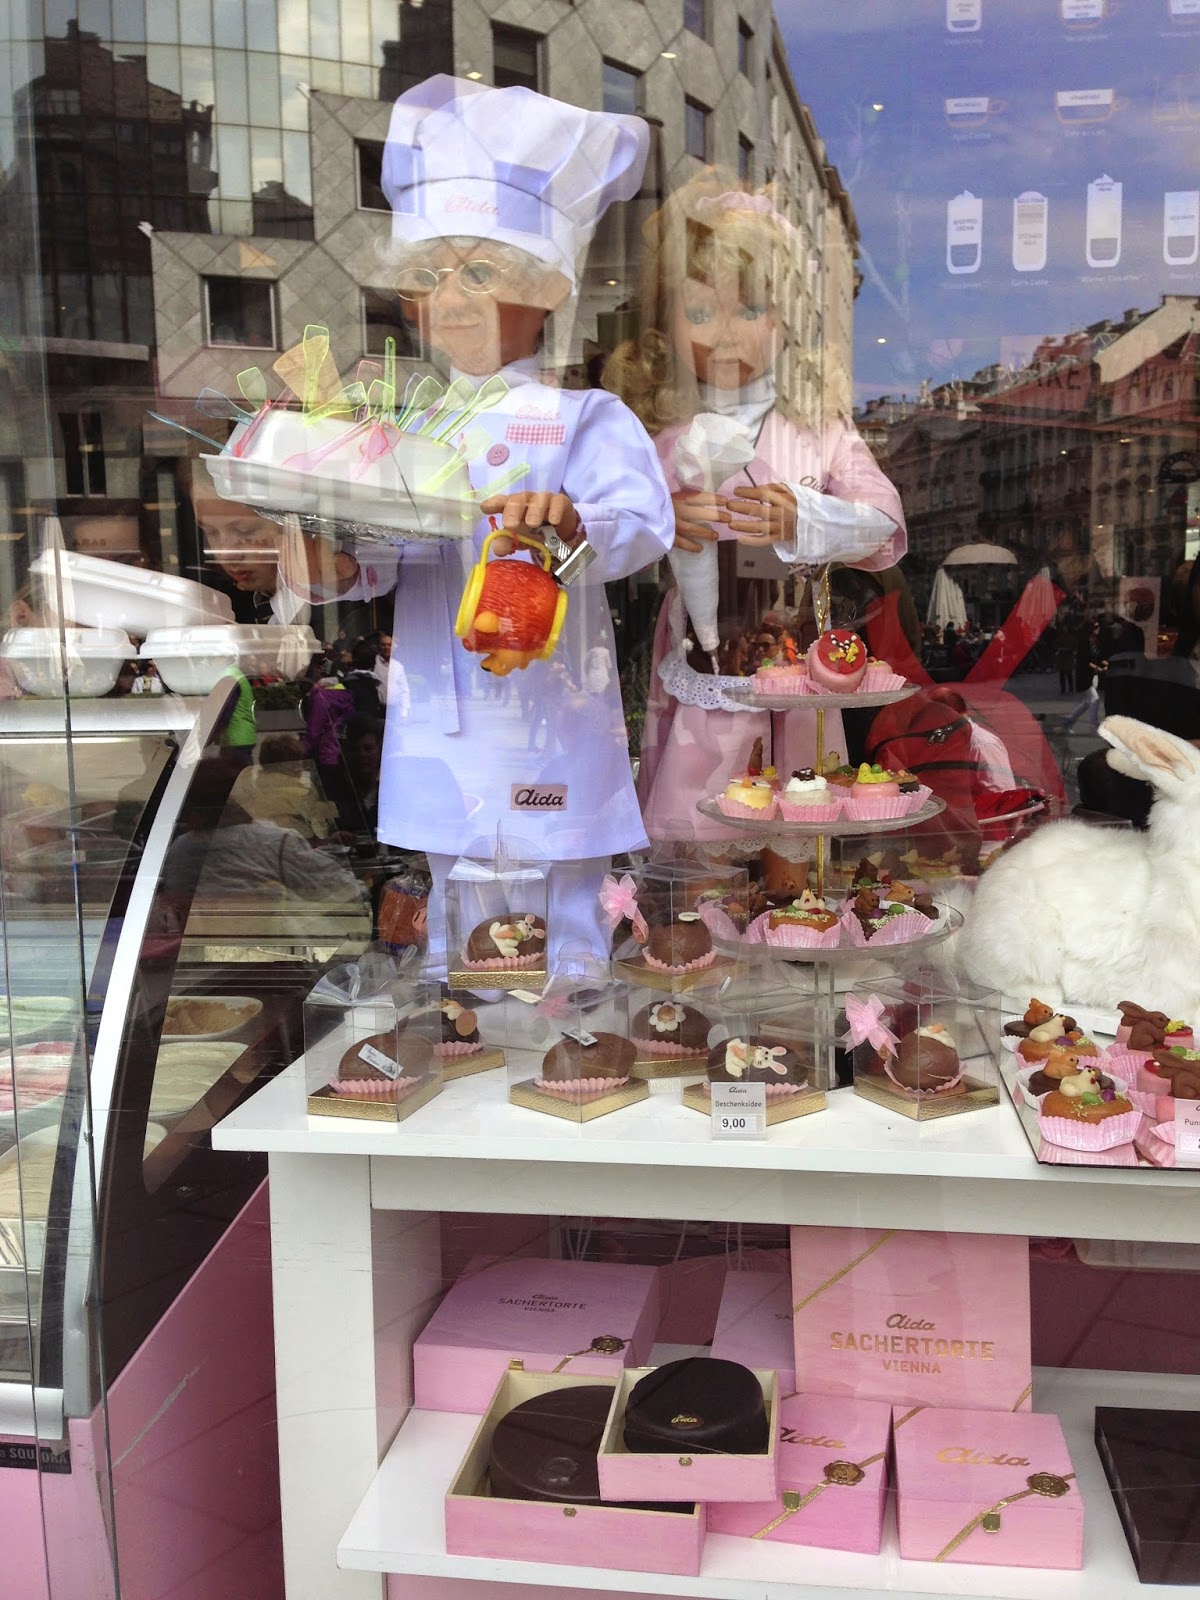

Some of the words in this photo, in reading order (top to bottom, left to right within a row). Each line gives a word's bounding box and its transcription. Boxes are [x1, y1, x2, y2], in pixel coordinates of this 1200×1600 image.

[714, 1100, 762, 1108] Geschenksidee
[722, 1118, 746, 1129] 9,00
[497, 1297, 588, 1310] SACHERTORTE
[830, 1331, 995, 1361] SACHERTORTE
[882, 1359, 942, 1375] VIENNA
